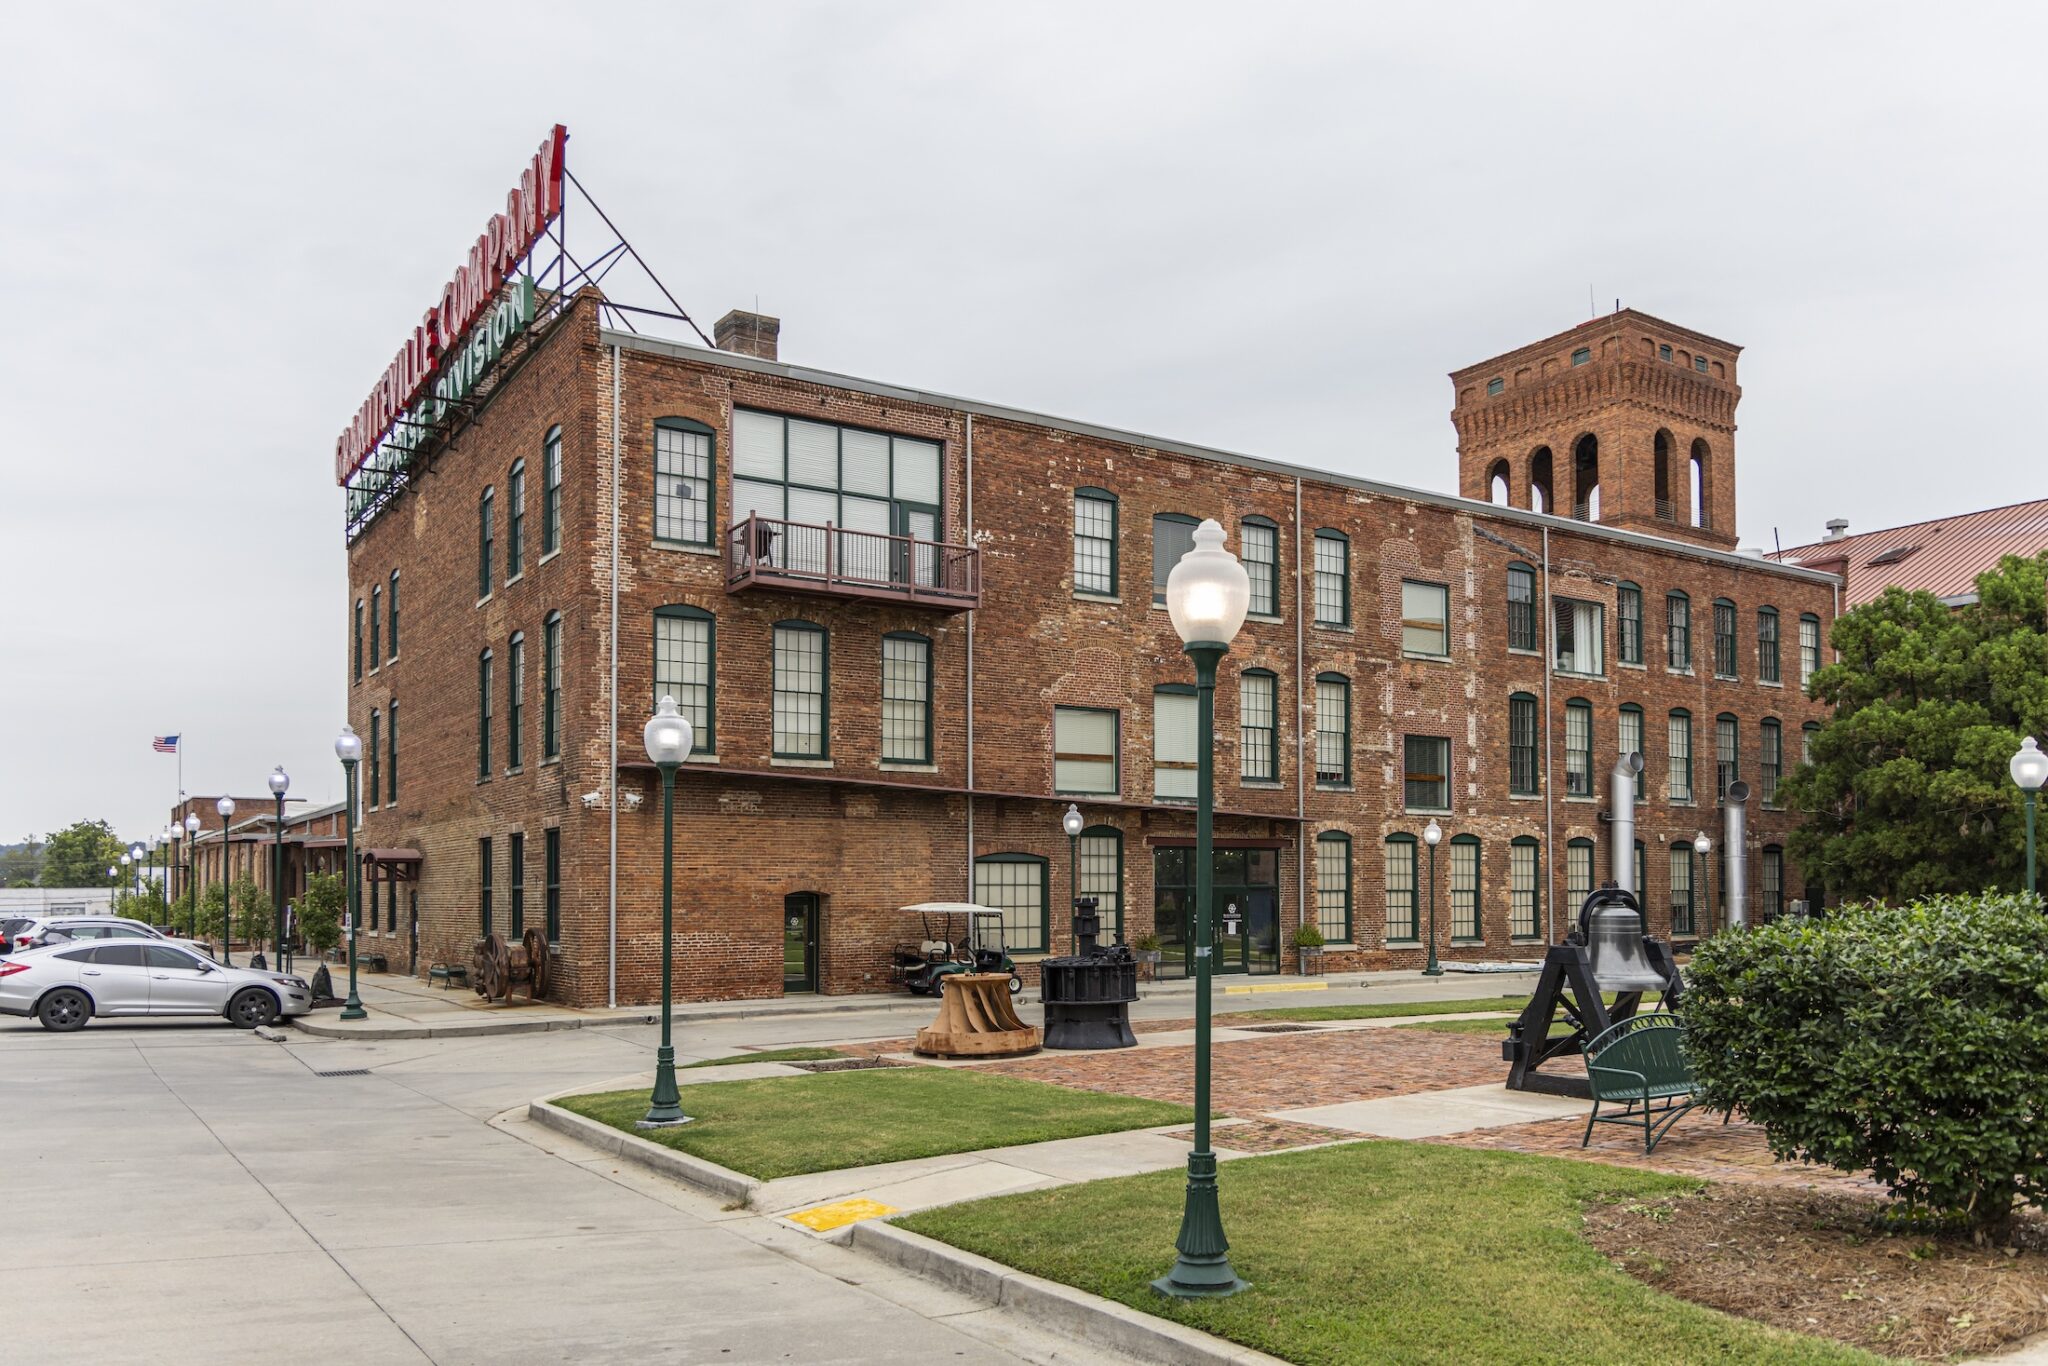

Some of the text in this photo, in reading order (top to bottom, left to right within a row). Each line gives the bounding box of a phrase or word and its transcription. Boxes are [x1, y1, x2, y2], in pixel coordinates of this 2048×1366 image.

[336, 123, 567, 487] GRANITEVILLE COMPANY
[435, 275, 535, 421] DIVISION
